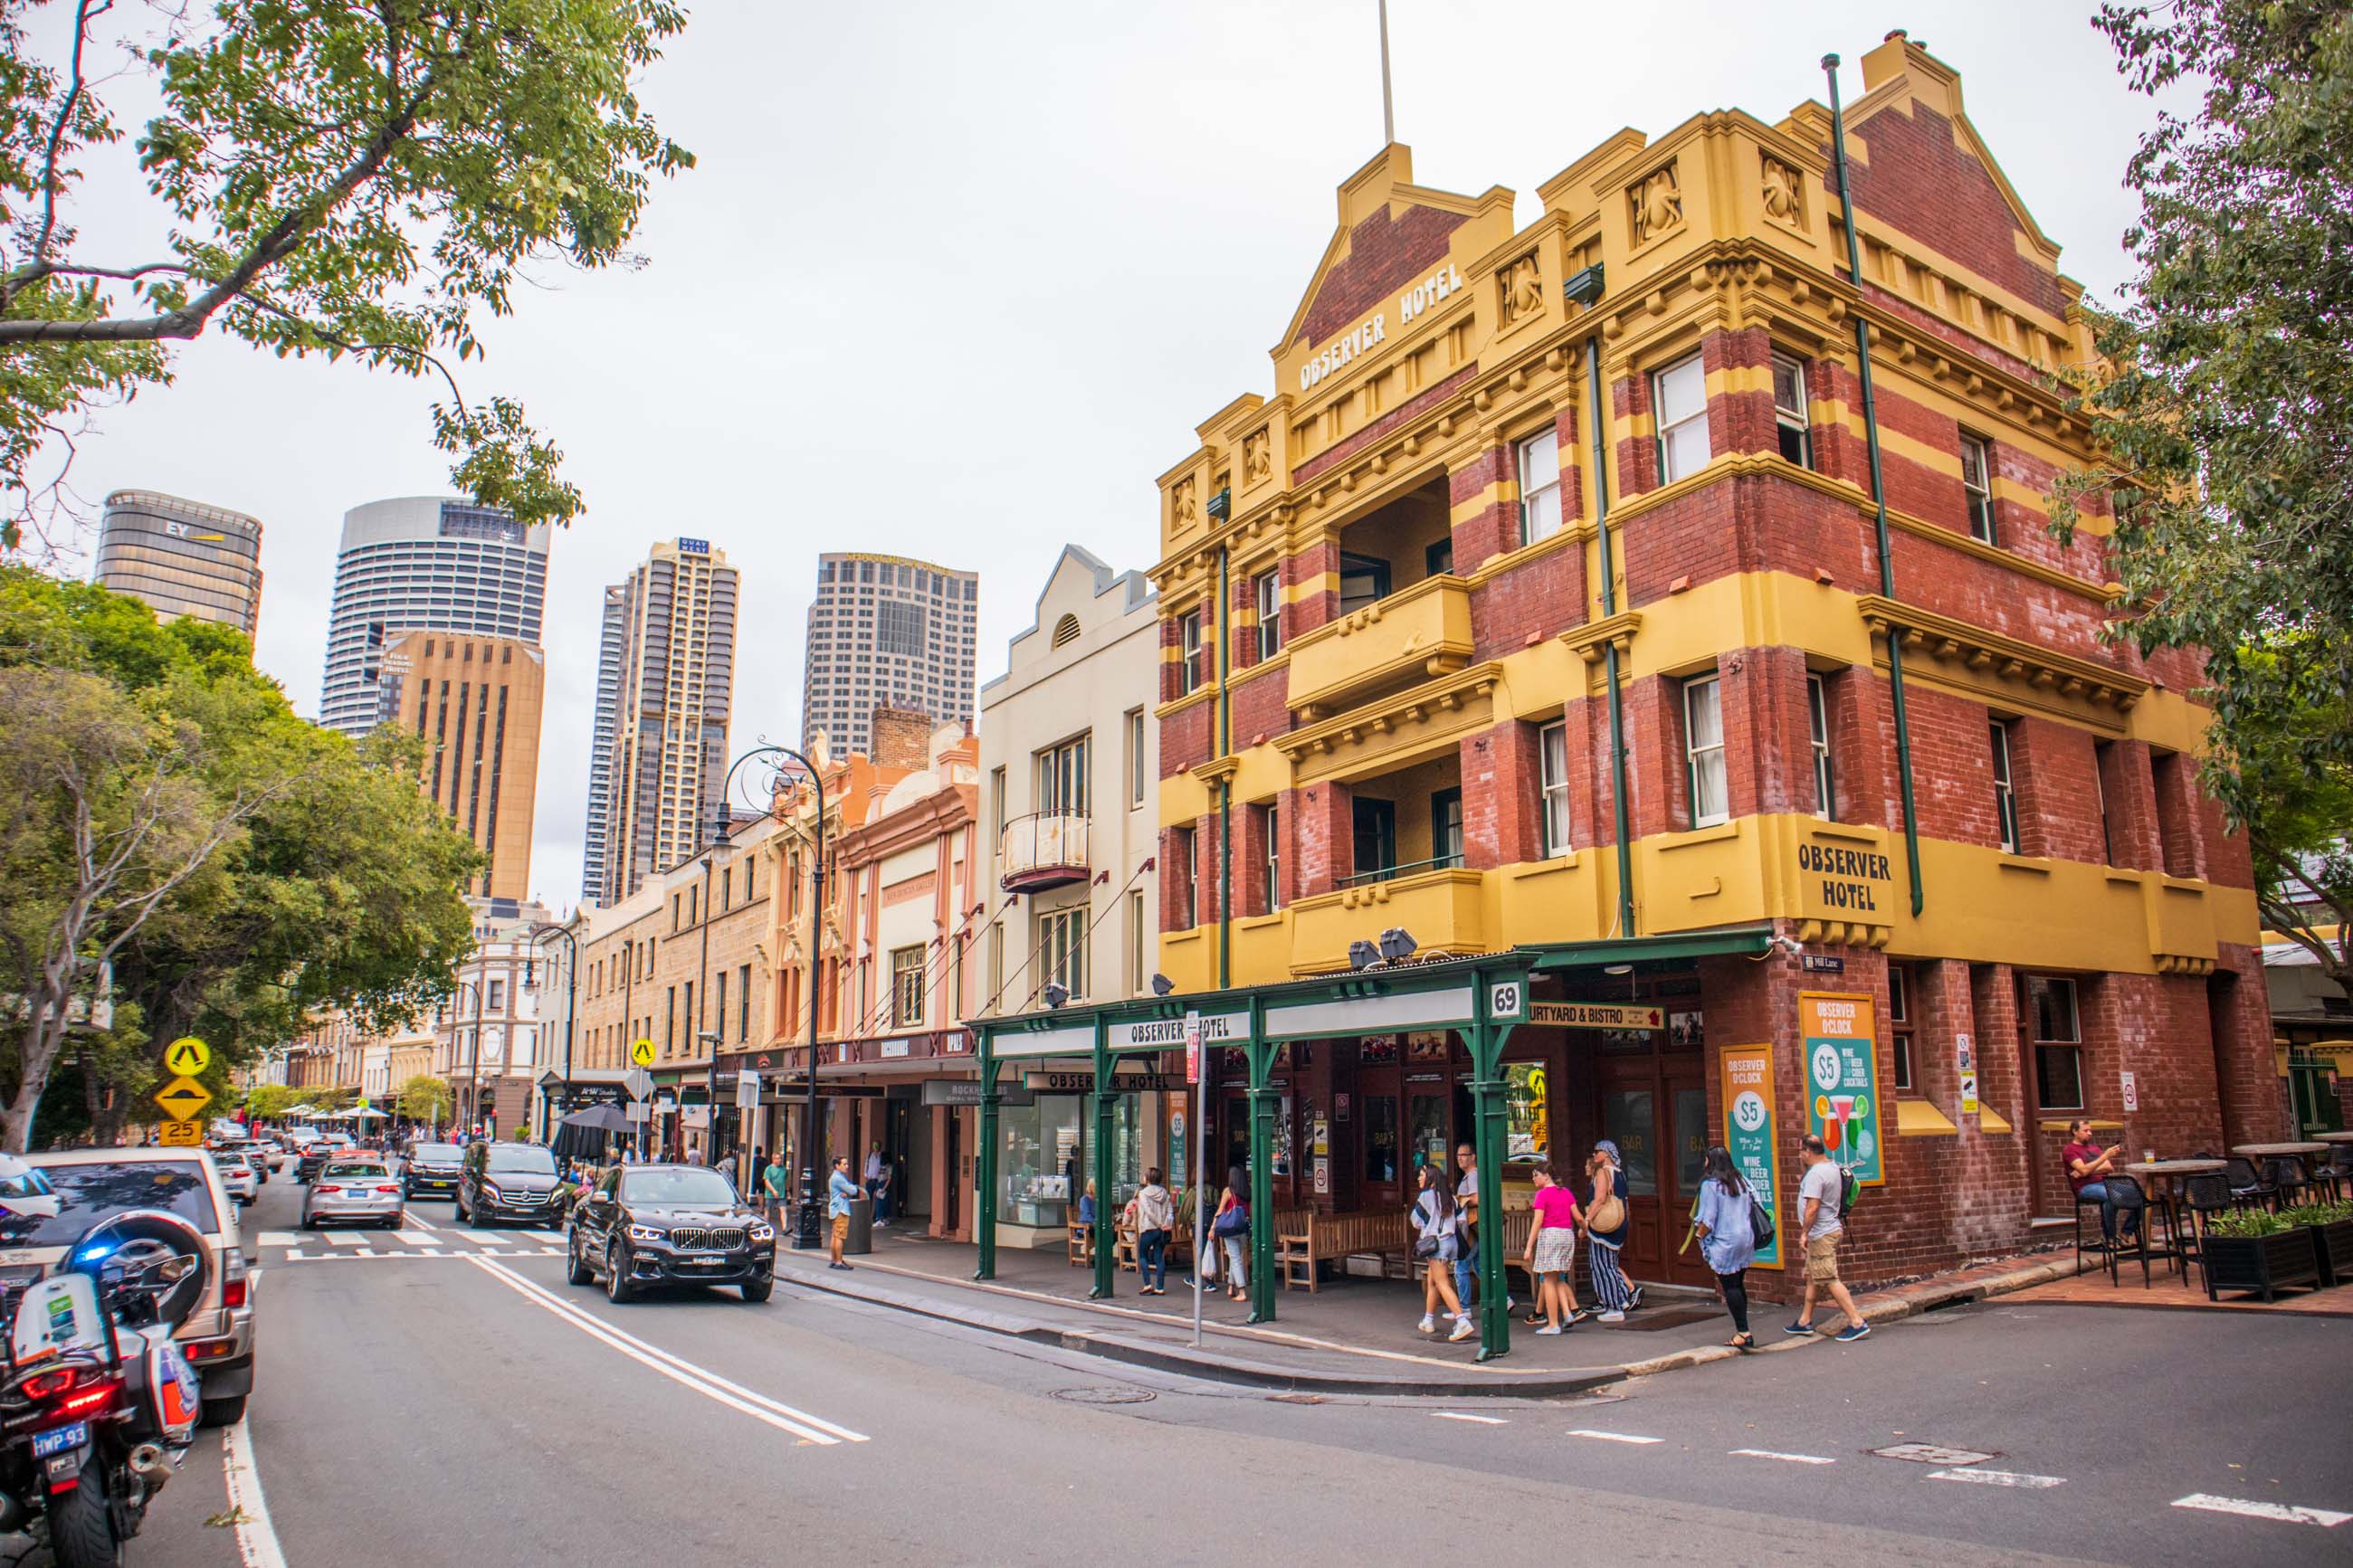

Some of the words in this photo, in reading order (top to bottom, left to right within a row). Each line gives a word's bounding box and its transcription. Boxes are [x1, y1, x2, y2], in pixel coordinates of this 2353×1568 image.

[1300, 313, 1386, 391] OBSERVER
[1401, 262, 1462, 325] HOTEL
[166, 521, 189, 537] EY
[681, 538, 707, 547] QUAY
[1799, 843, 1891, 880] OBSERVER
[1823, 880, 1875, 911] HOTEL
[1815, 956, 1824, 967] Mill
[1825, 957, 1838, 967] Lane
[1494, 986, 1517, 1012] 69
[1529, 1005, 1577, 1022] URTYARD
[1579, 1008, 1586, 1022] &
[1588, 1009, 1623, 1023] BISTRO
[1817, 1003, 1855, 1018] OBSERVER
[1131, 1022, 1185, 1043] OBSERVER
[1823, 1019, 1853, 1034] O'CLOCK
[1728, 1060, 1766, 1073] OBSERVER
[1818, 1055, 1834, 1080] $5
[1050, 1074, 1120, 1088] OBSERR
[1129, 1075, 1168, 1088] HOTEL
[1732, 1072, 1762, 1084] O'CLOCK
[1741, 1100, 1758, 1123] $5
[168, 1123, 194, 1137] 25
[1622, 1136, 1643, 1151] BAR
[1689, 1136, 1706, 1152] BA
[1743, 1156, 1761, 1167] WINE
[1750, 1168, 1767, 1179] BEER
[33, 1433, 63, 1457] HWP
[66, 1427, 86, 1445] 93
